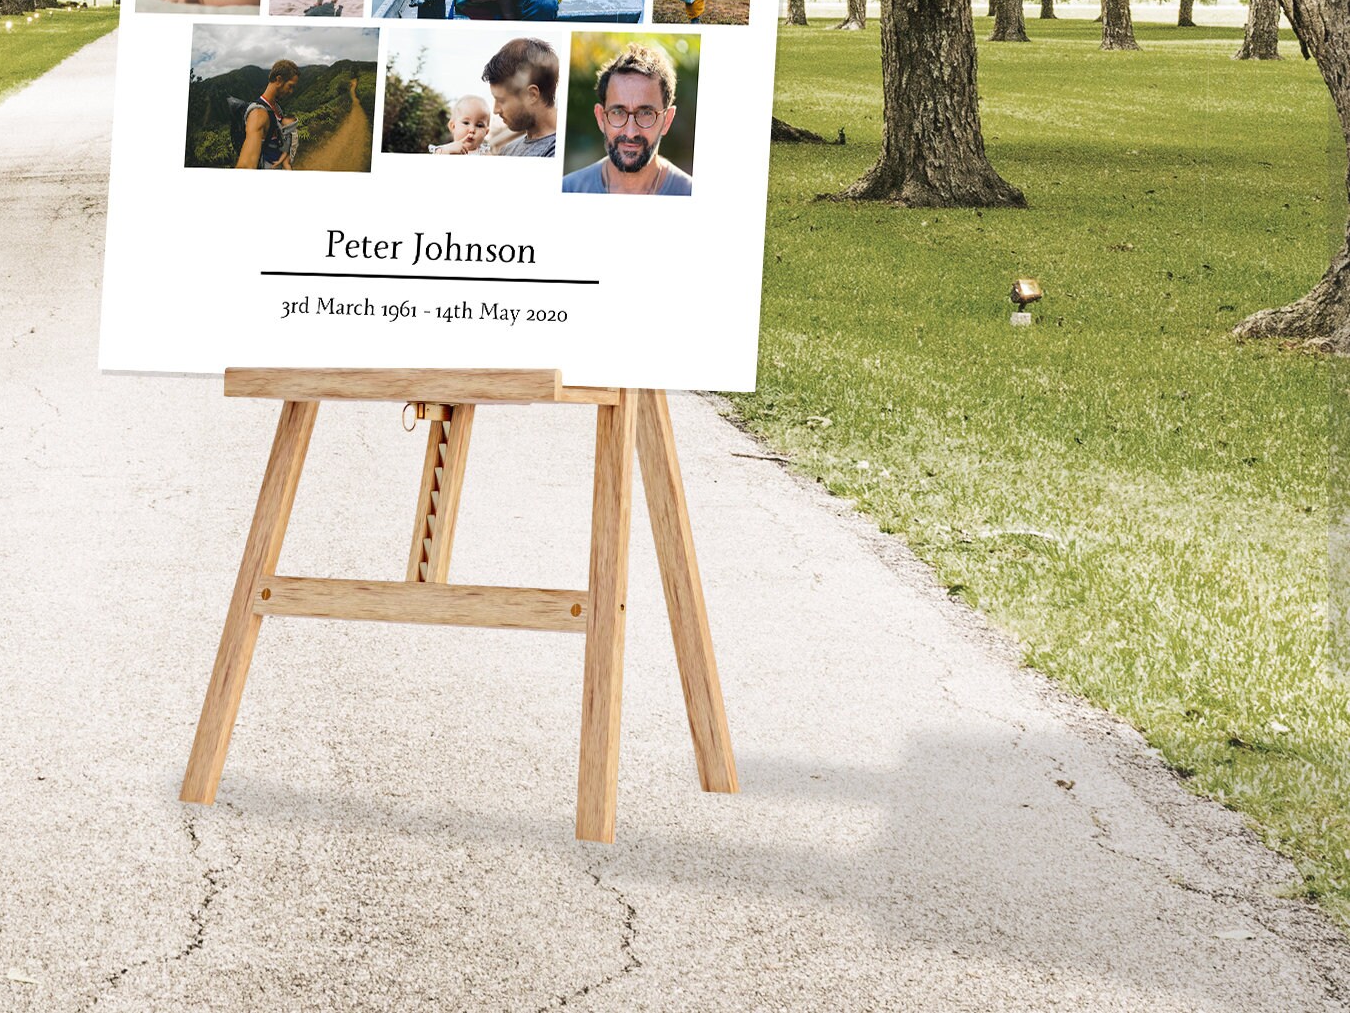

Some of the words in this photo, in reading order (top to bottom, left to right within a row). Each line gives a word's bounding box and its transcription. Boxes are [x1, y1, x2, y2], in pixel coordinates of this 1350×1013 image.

[324, 228, 404, 261] Peter
[411, 231, 537, 266] Johnson
[280, 295, 310, 319] 3rd
[315, 296, 376, 316] March
[380, 299, 418, 323] 1961
[435, 300, 473, 323] 14th
[478, 301, 522, 327] May
[526, 309, 568, 323] 2020
